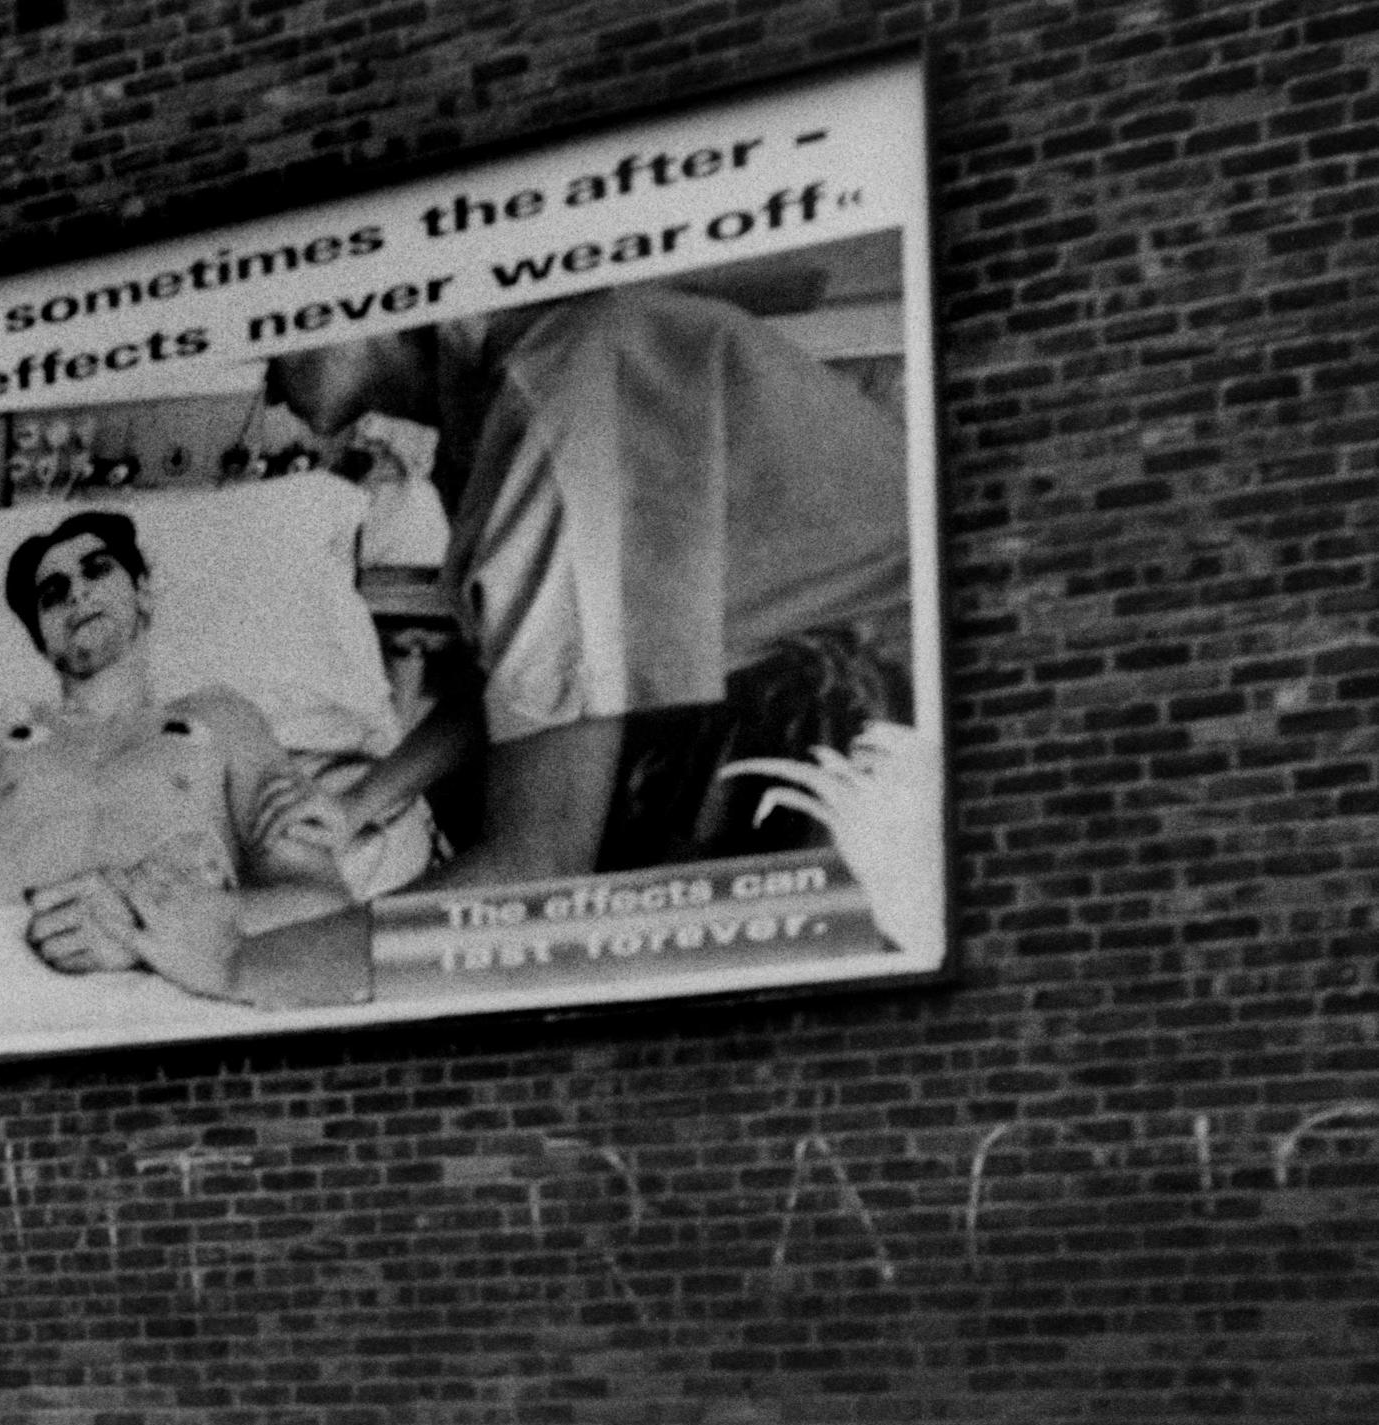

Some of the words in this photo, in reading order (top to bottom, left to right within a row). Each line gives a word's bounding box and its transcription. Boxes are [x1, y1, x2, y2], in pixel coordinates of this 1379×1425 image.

[421, 192, 545, 239] the
[247, 274, 454, 342] never
[490, 222, 690, 288] wear
[444, 900, 527, 928] The
[544, 879, 713, 921] effects
[731, 866, 827, 899] can
[441, 939, 551, 972] last
[586, 913, 829, 960] forever.
